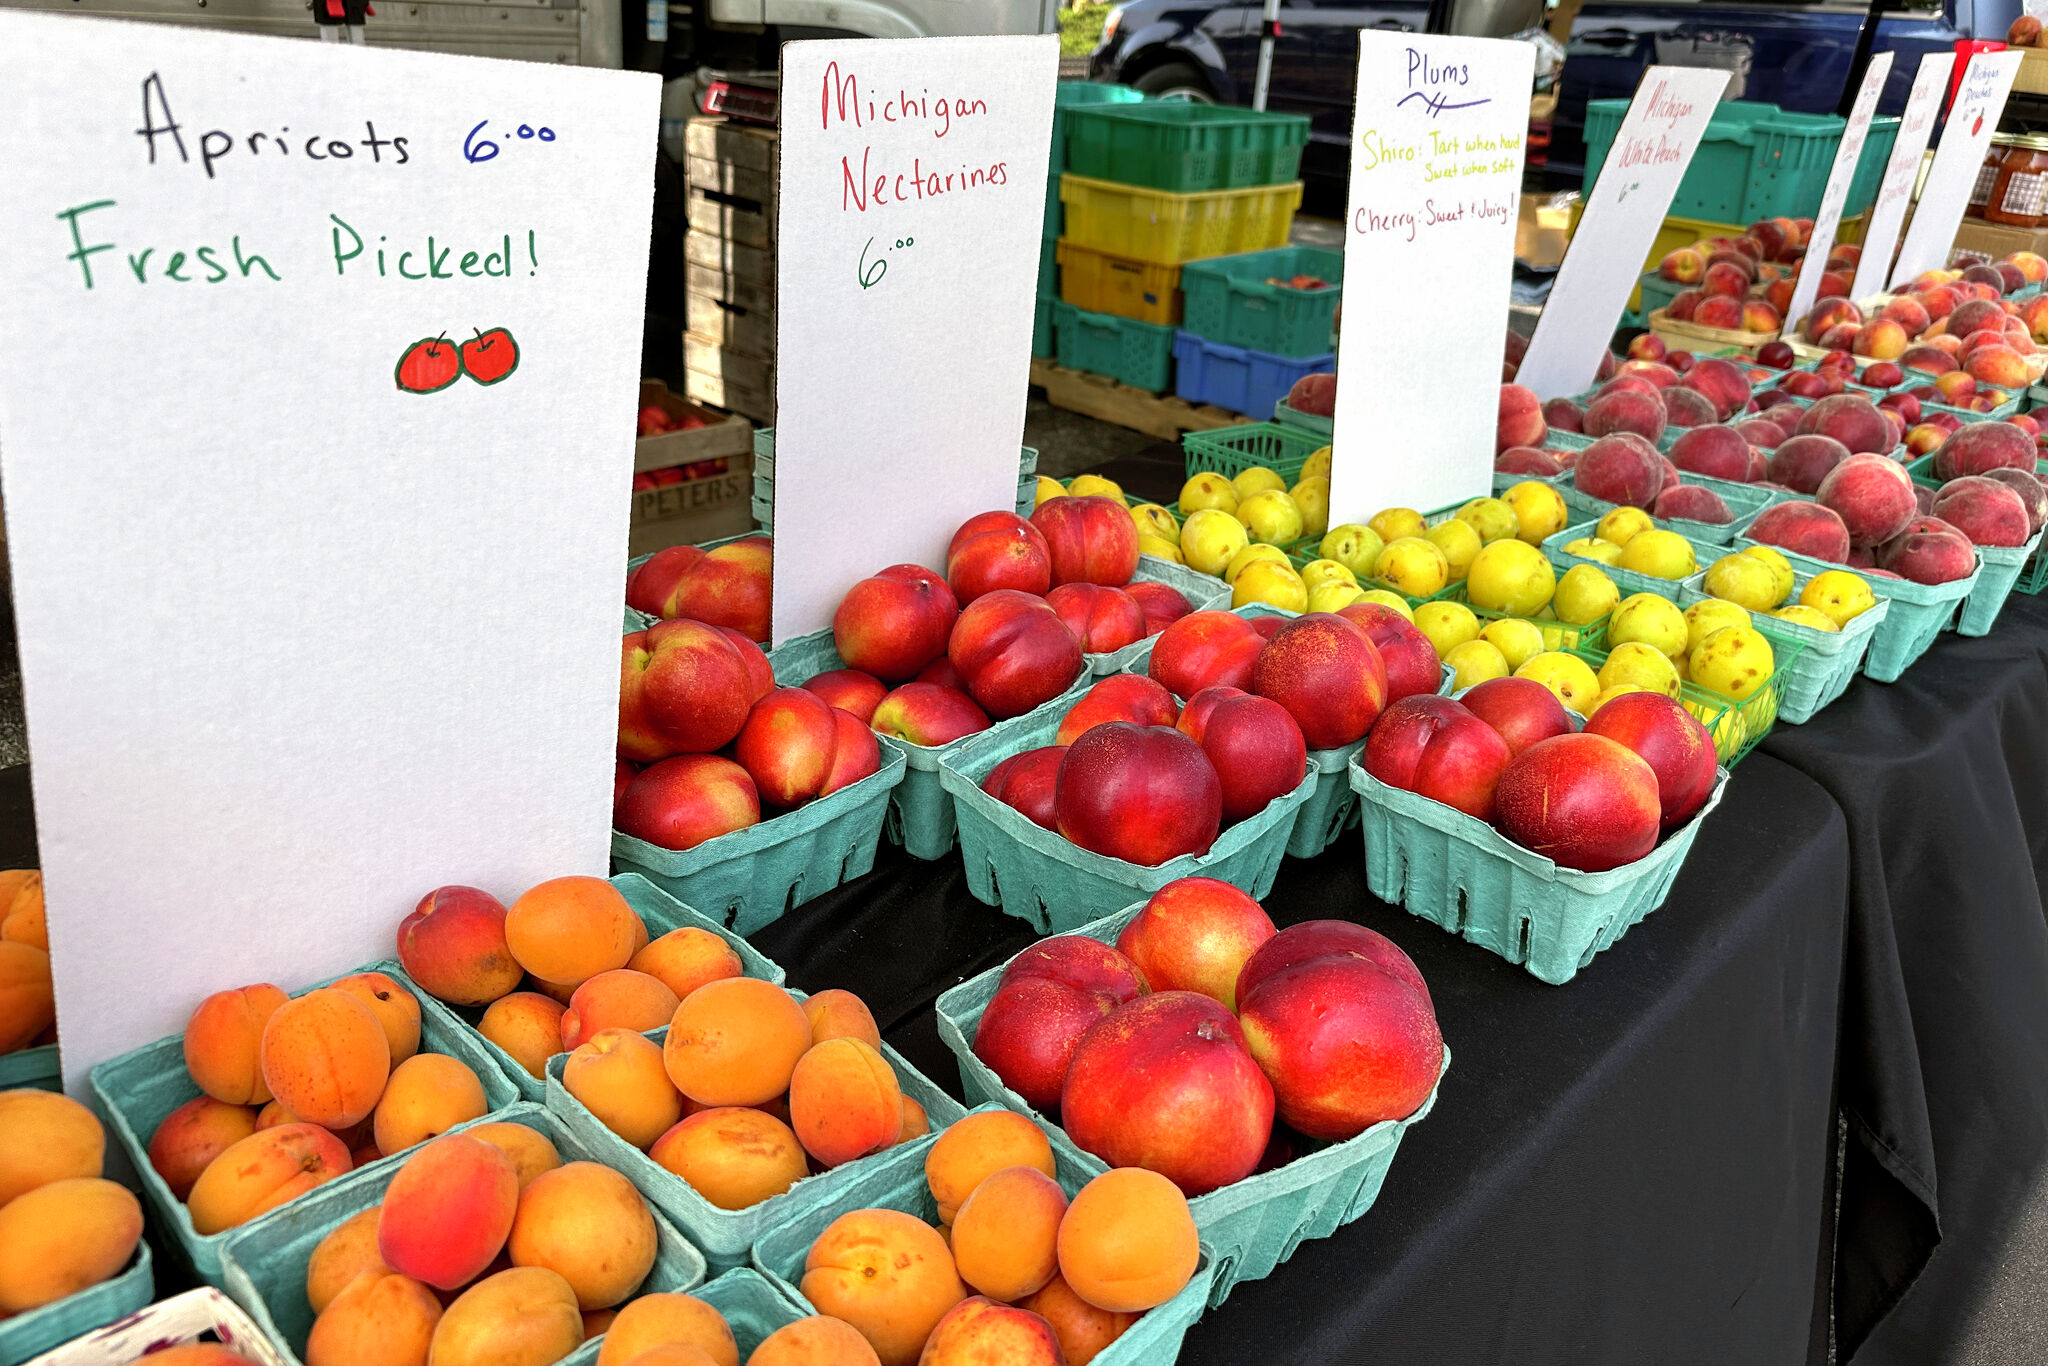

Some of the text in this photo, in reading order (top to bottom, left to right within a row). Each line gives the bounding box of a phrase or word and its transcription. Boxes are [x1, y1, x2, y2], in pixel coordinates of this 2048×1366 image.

[1405, 47, 1469, 89] Plums
[822, 60, 987, 138] Michigan
[1642, 80, 1693, 129] Michigan
[135, 71, 557, 179] Apricots 6.00
[1362, 129, 1521, 171] Shiro: Tart when hard
[1424, 157, 1515, 183] Sweet when soft
[1618, 134, 1682, 168] White Peach
[842, 146, 1007, 212] Nectarines
[1355, 207, 1423, 242] Cherry:
[1425, 199, 1465, 226] Sweet
[1477, 191, 1516, 225] Juicy!
[57, 199, 540, 289] Fresh Picked!
[858, 236, 915, 290] 6.00
[640, 475, 740, 519] PETERS
